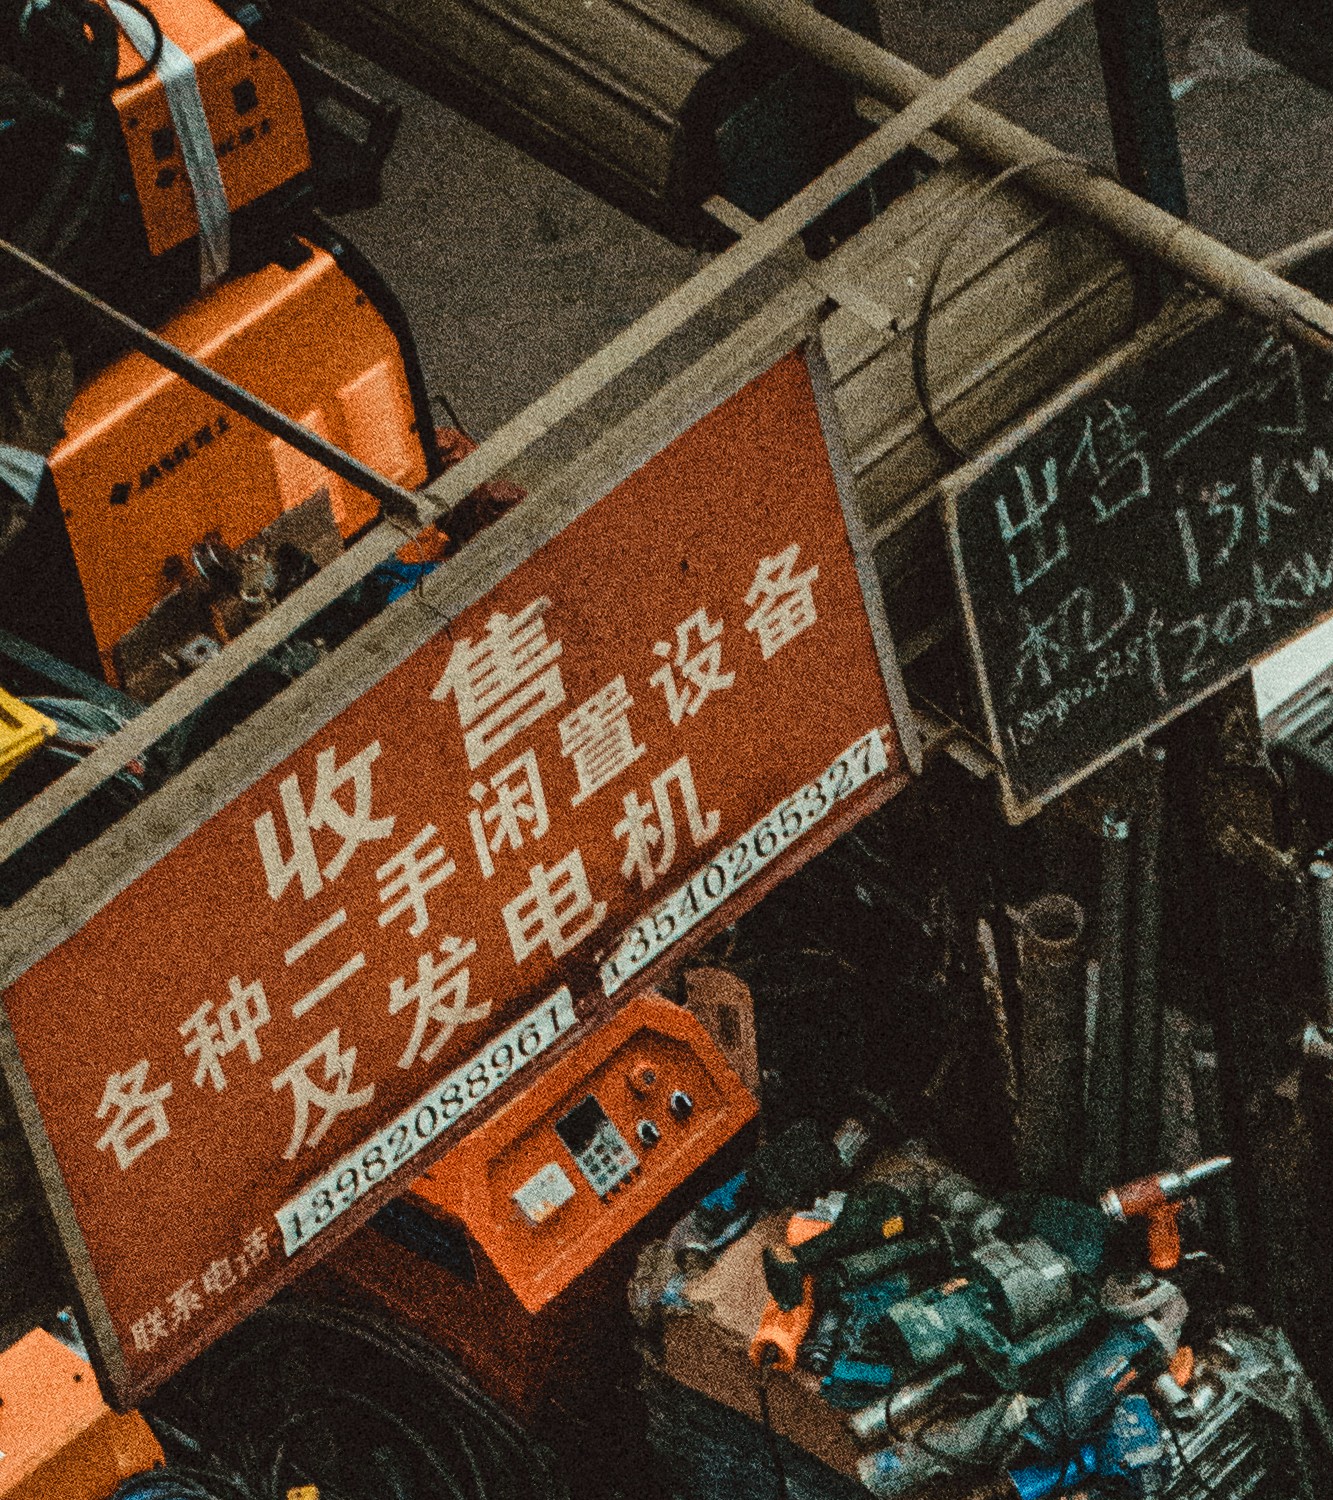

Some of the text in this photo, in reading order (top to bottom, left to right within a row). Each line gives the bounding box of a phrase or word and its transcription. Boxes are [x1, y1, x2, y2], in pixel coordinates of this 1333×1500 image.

[94, 543, 820, 1172] 各种二手闲置设备
[1012, 576, 1137, 687] 机
[129, 738, 879, 1353] 联系电话 13982088961 13540265327
[270, 754, 721, 1161] 及发电机
